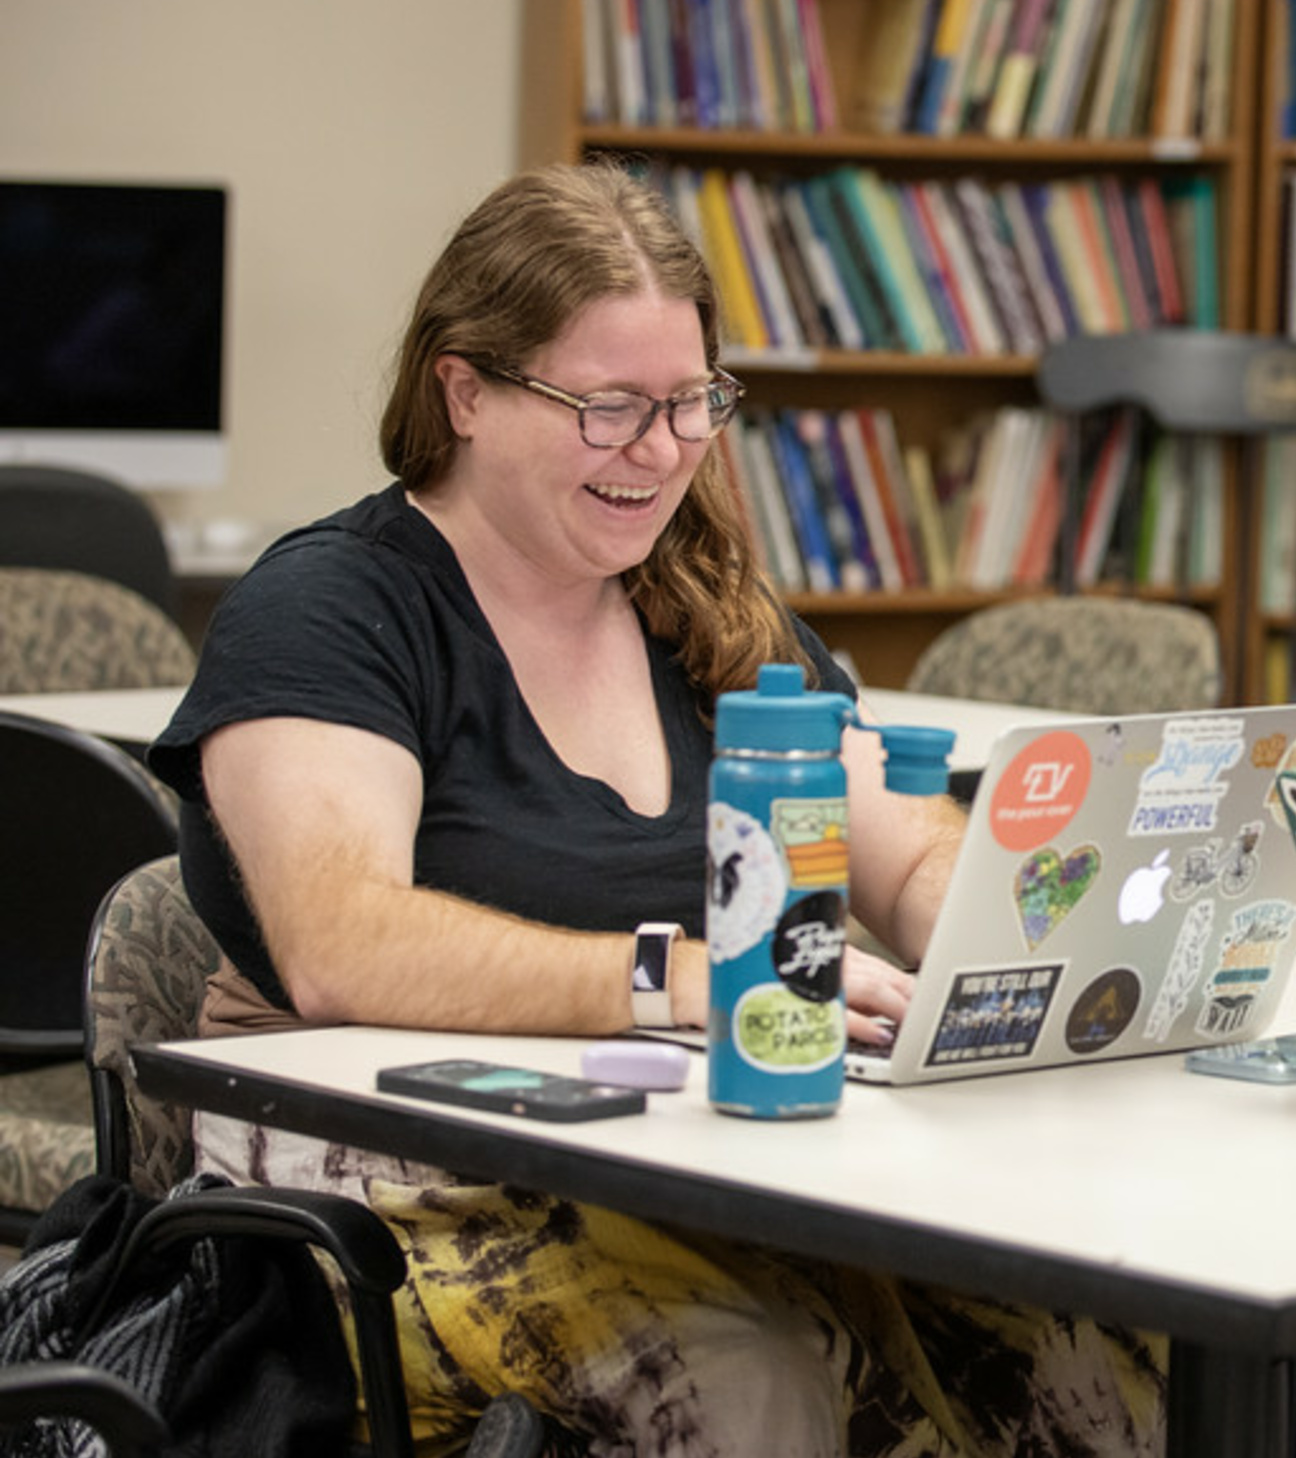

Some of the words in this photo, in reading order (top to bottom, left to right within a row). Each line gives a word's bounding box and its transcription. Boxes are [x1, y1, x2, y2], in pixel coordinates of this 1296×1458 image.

[1132, 803, 1214, 831] POWERFUL
[746, 1006, 830, 1032] POTATO
[773, 1025, 839, 1050] PARCEL
